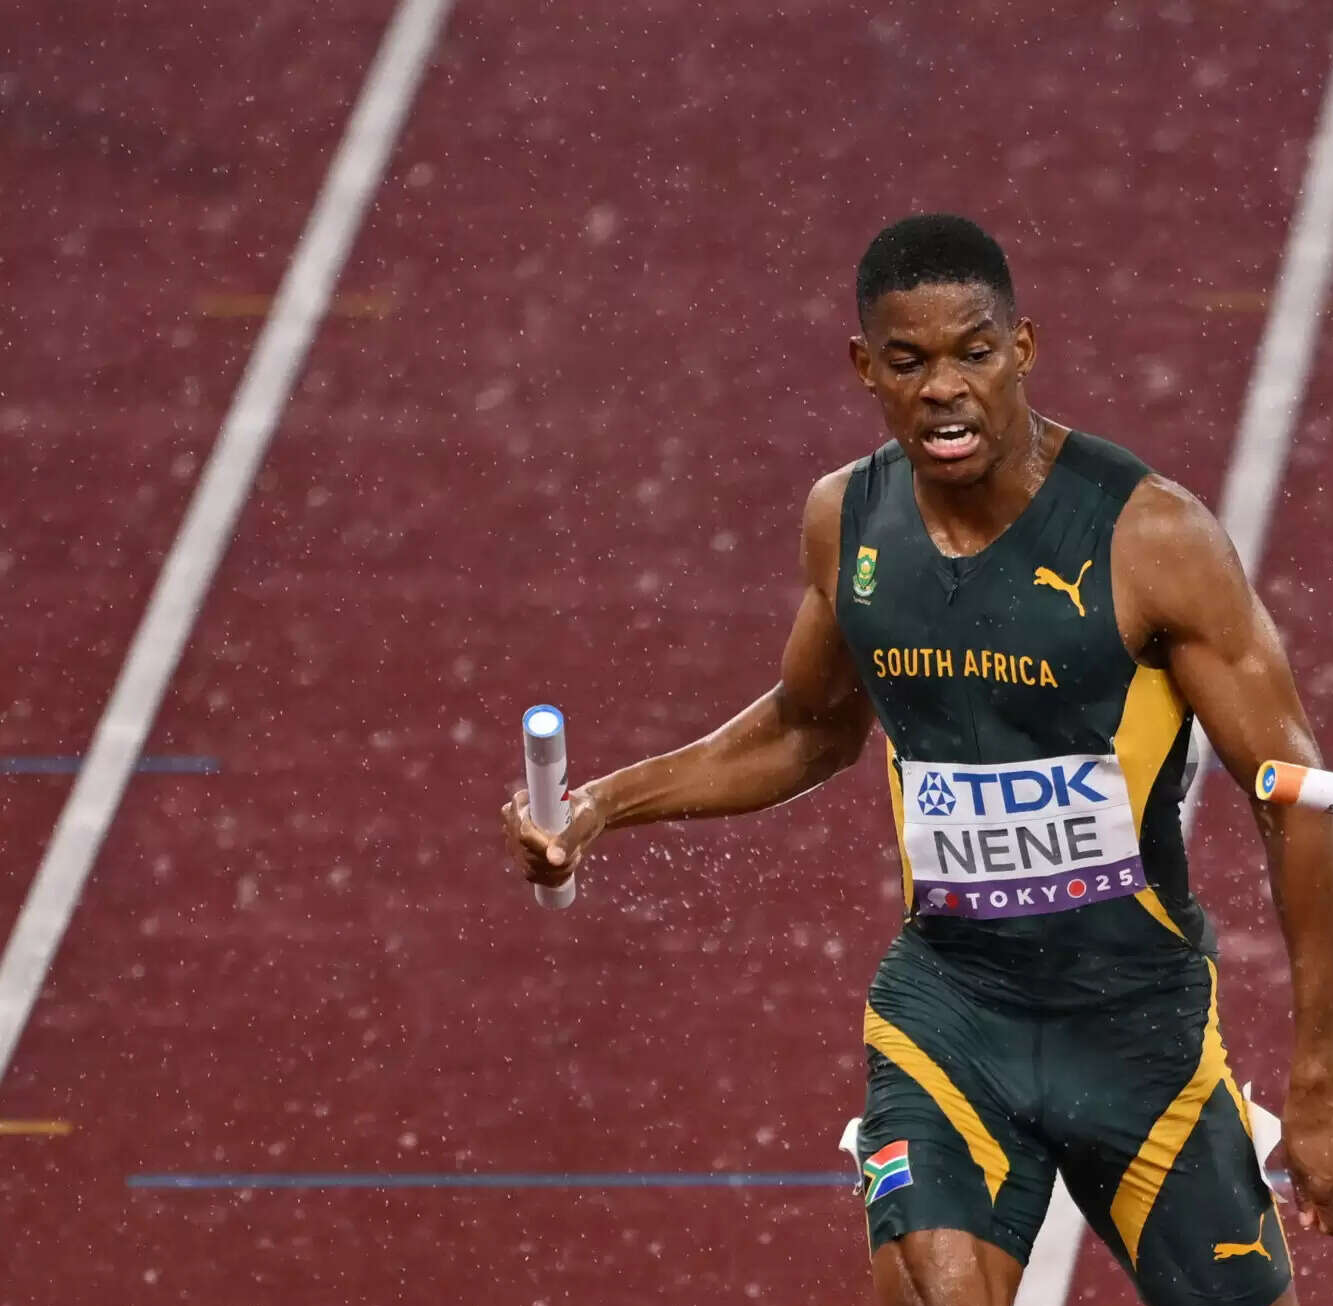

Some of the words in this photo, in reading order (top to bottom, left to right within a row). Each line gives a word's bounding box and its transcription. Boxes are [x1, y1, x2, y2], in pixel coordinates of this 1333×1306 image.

[873, 647, 954, 678] SOUTH
[963, 649, 1059, 689] AFRICA
[952, 761, 1109, 816] TDK
[933, 816, 1103, 875] NENE
[1096, 868, 1134, 892] 25
